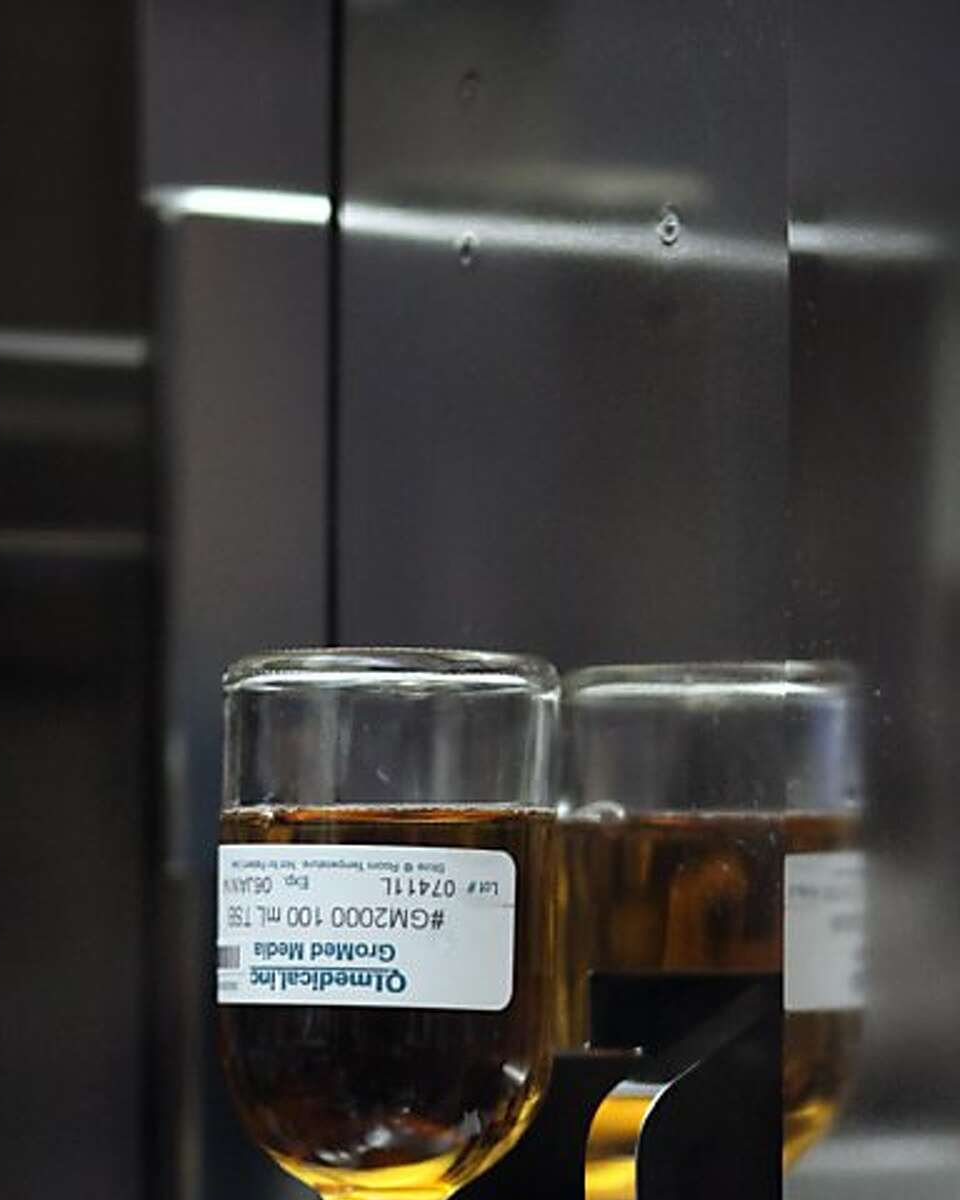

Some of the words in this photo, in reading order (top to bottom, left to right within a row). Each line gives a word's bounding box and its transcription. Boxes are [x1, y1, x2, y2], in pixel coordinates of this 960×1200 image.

[367, 860, 399, 873] Room
[380, 877, 457, 898] 07411L
[479, 881, 499, 896] Lot
[257, 905, 281, 926] mL
[287, 906, 323, 928] 100
[332, 906, 445, 930] #GM2000
[254, 942, 305, 961] Media
[310, 942, 396, 963] GroMed
